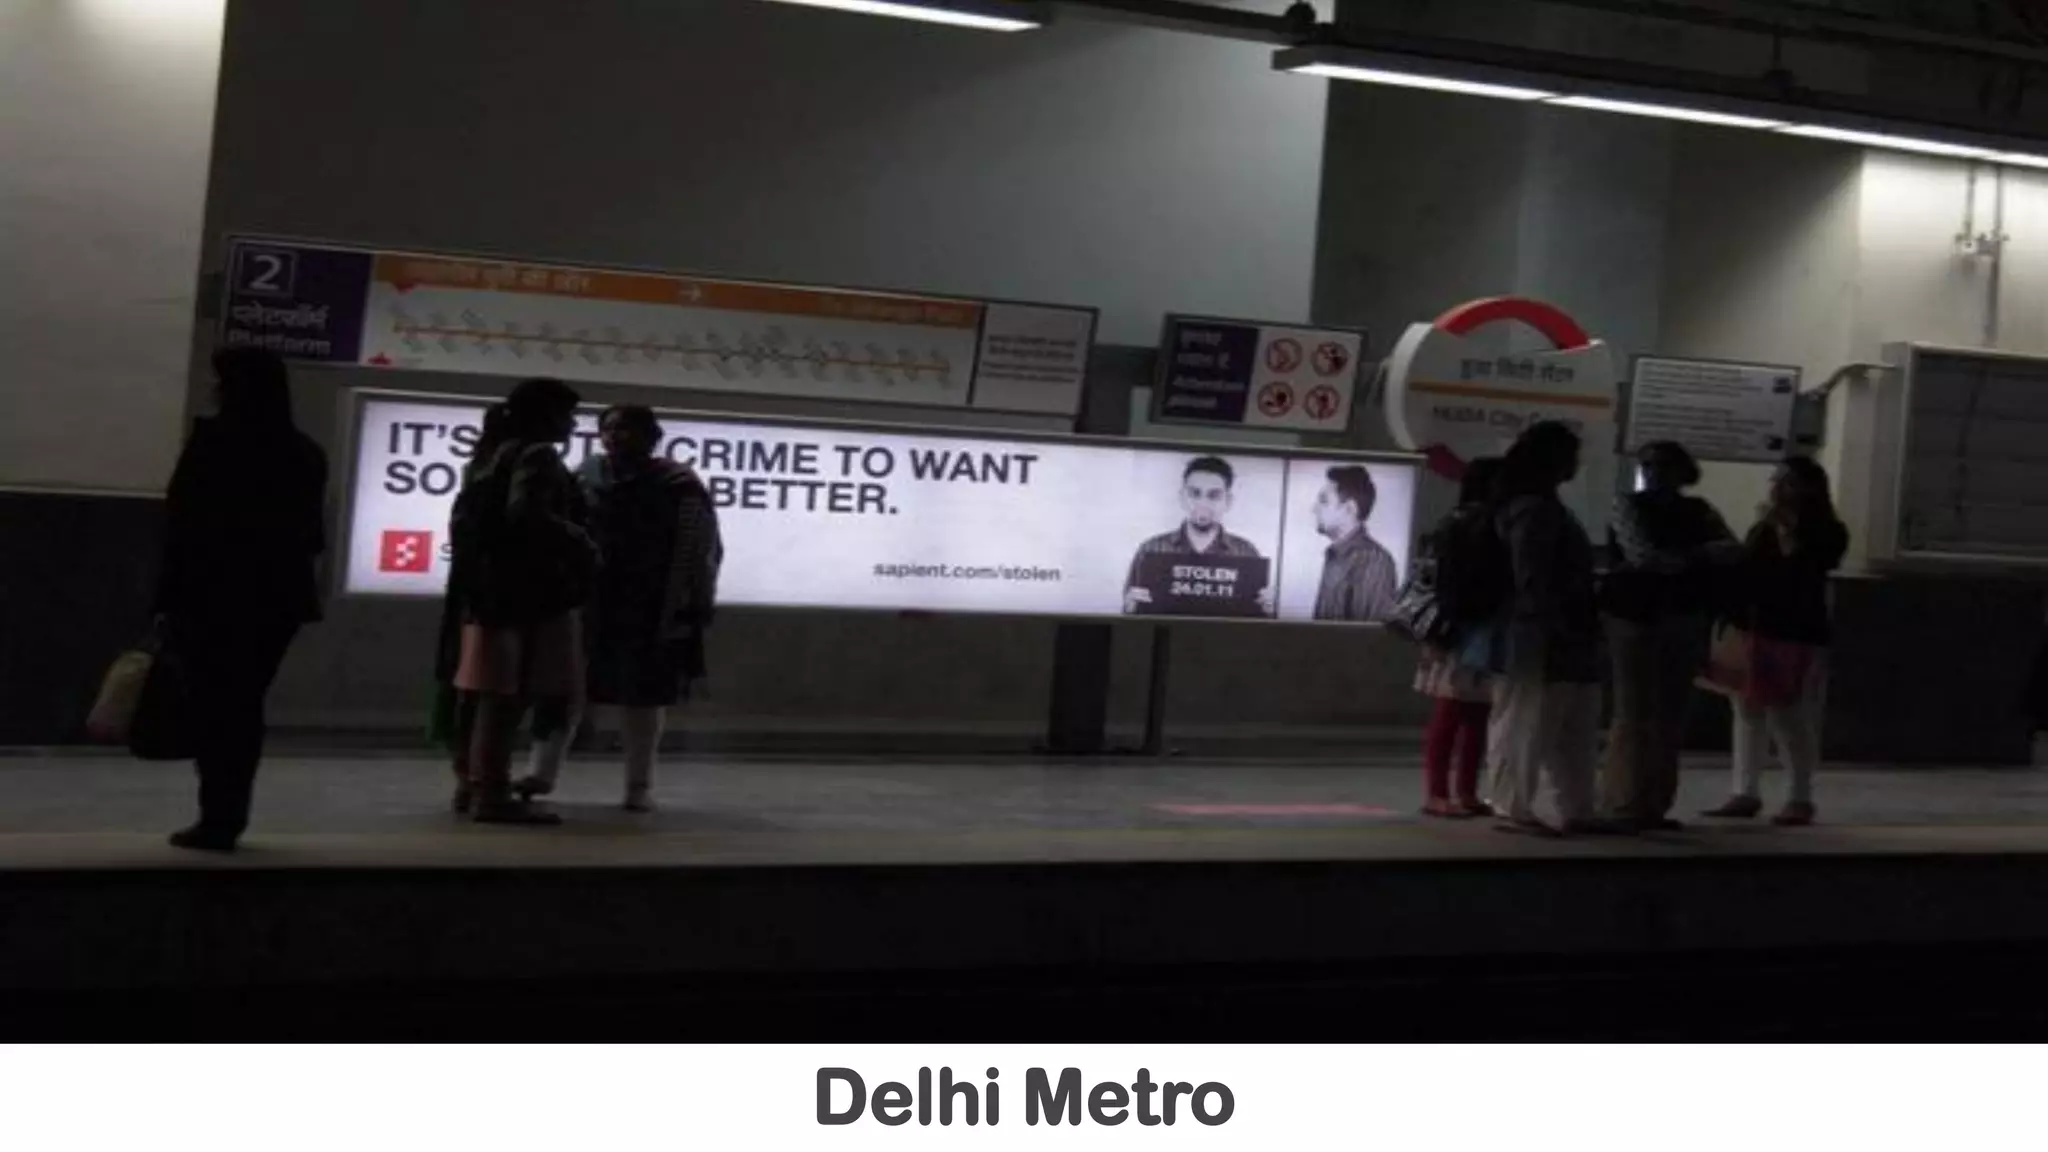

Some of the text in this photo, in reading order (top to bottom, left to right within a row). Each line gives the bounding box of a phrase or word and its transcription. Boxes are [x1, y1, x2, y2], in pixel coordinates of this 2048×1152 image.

[249, 254, 284, 291] 2
[665, 436, 820, 475] CRIME
[834, 444, 895, 479] TO
[910, 448, 1039, 485] WANT
[708, 476, 899, 515] BETTER.
[873, 562, 1062, 582] sapient.com/stolen
[1171, 564, 1239, 582] STOLEN
